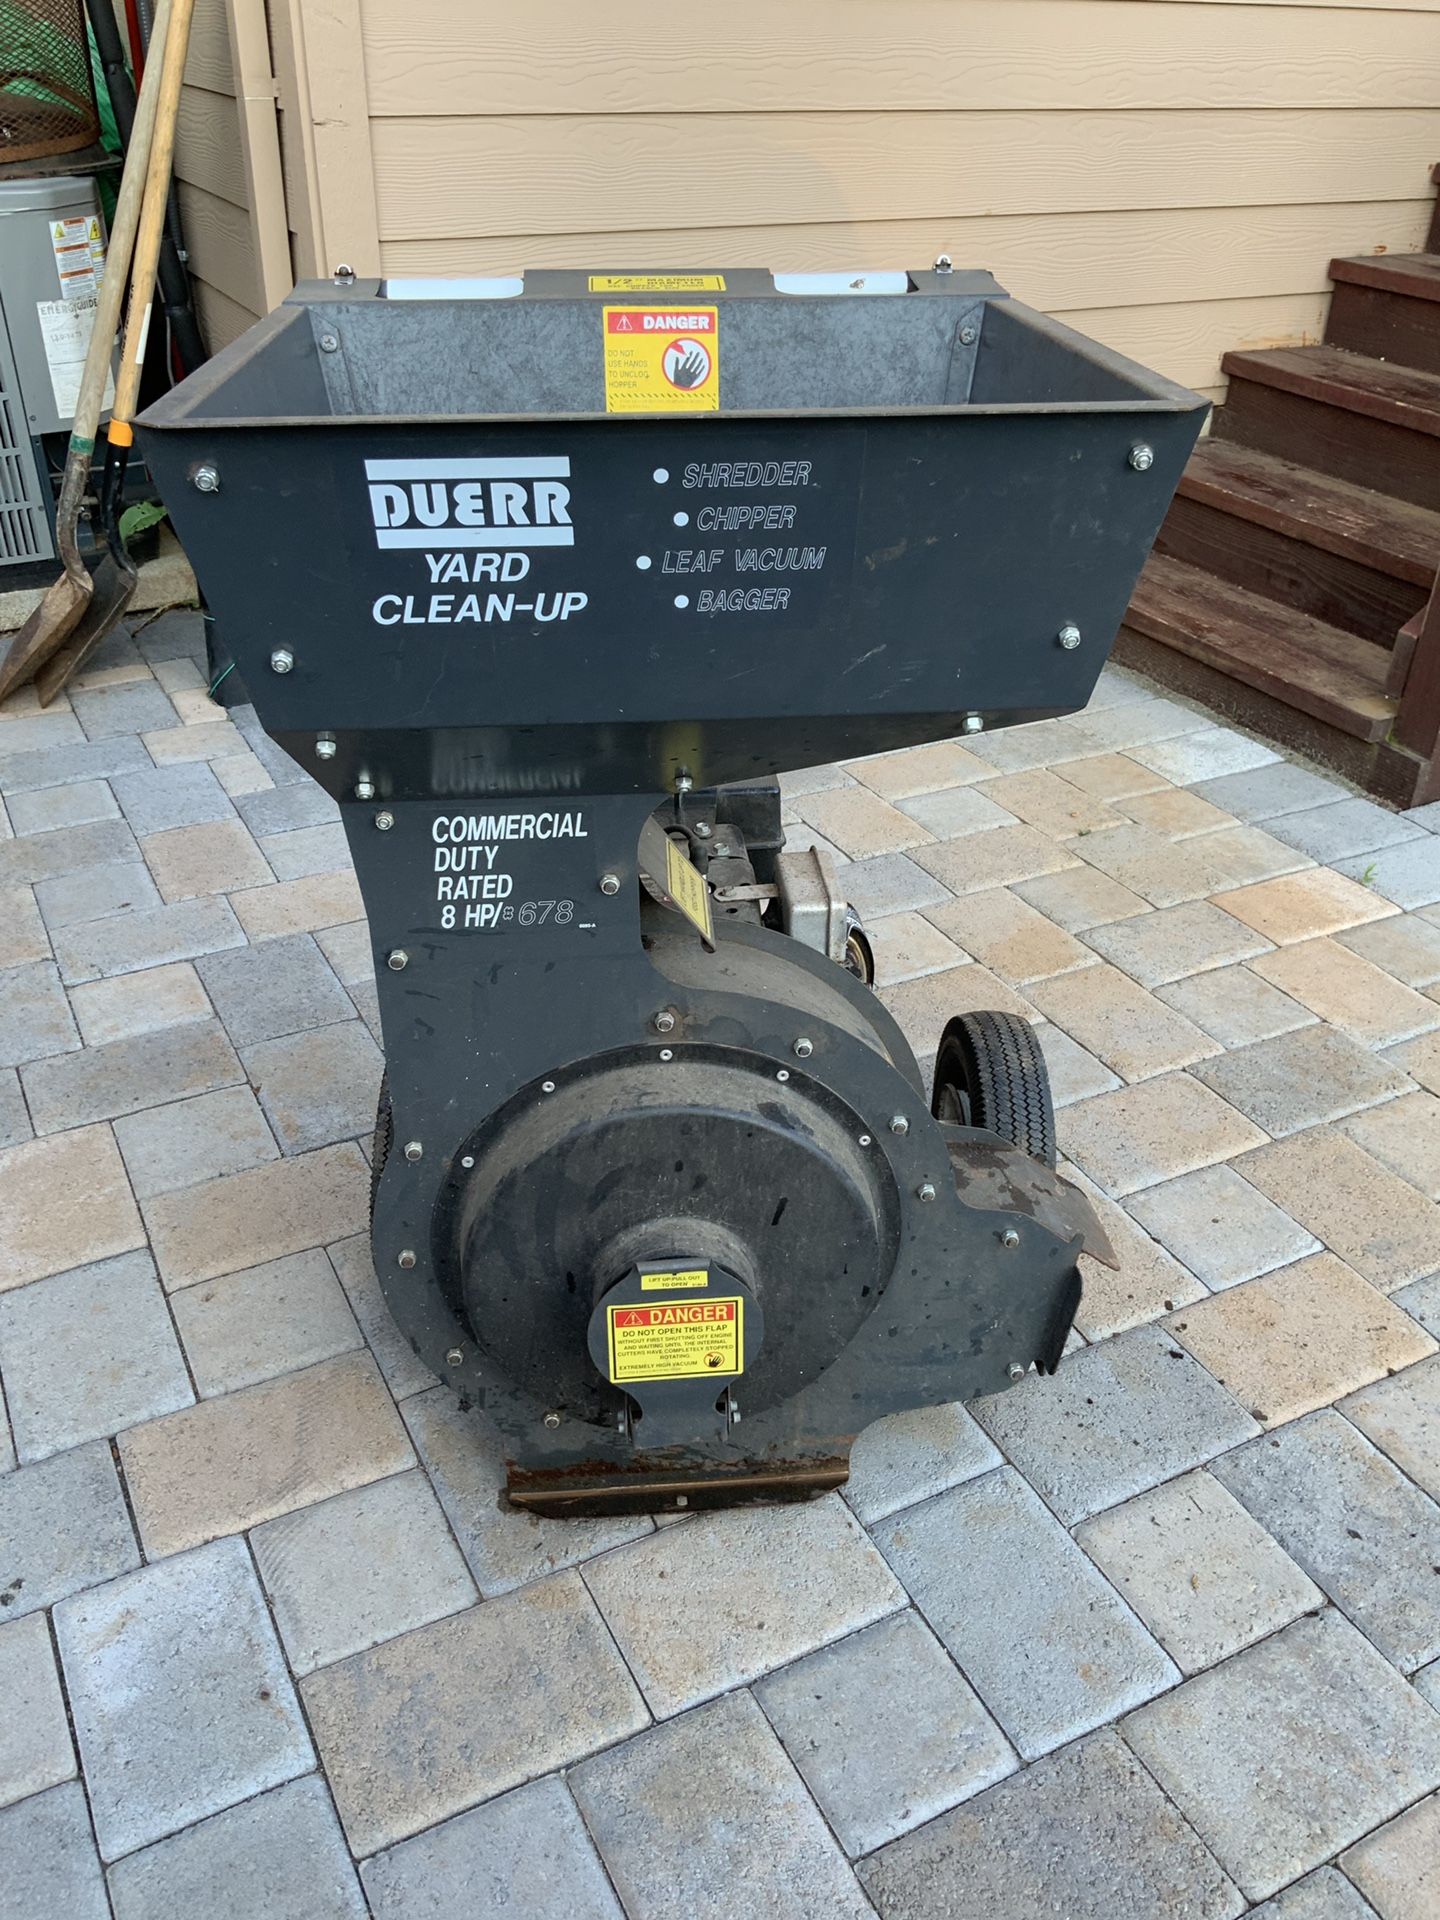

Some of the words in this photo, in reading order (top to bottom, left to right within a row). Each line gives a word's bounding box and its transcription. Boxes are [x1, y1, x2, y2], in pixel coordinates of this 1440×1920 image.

[643, 315, 709, 330] DANGER
[609, 370, 619, 378] TO
[682, 461, 812, 488] SHREDDER
[368, 481, 573, 527] DUERR
[697, 505, 797, 531] CHIPPER
[425, 552, 530, 583] YARD
[661, 550, 724, 574] LEAF
[734, 547, 827, 572] VACUUM
[372, 592, 588, 625] CLEAN-UP
[697, 588, 791, 612] BAGGER
[432, 812, 588, 843] COMMERCIAL
[434, 845, 499, 872] DUTY
[437, 874, 513, 900] RATED
[441, 905, 456, 929] 8
[650, 1306, 728, 1324] DANGER
